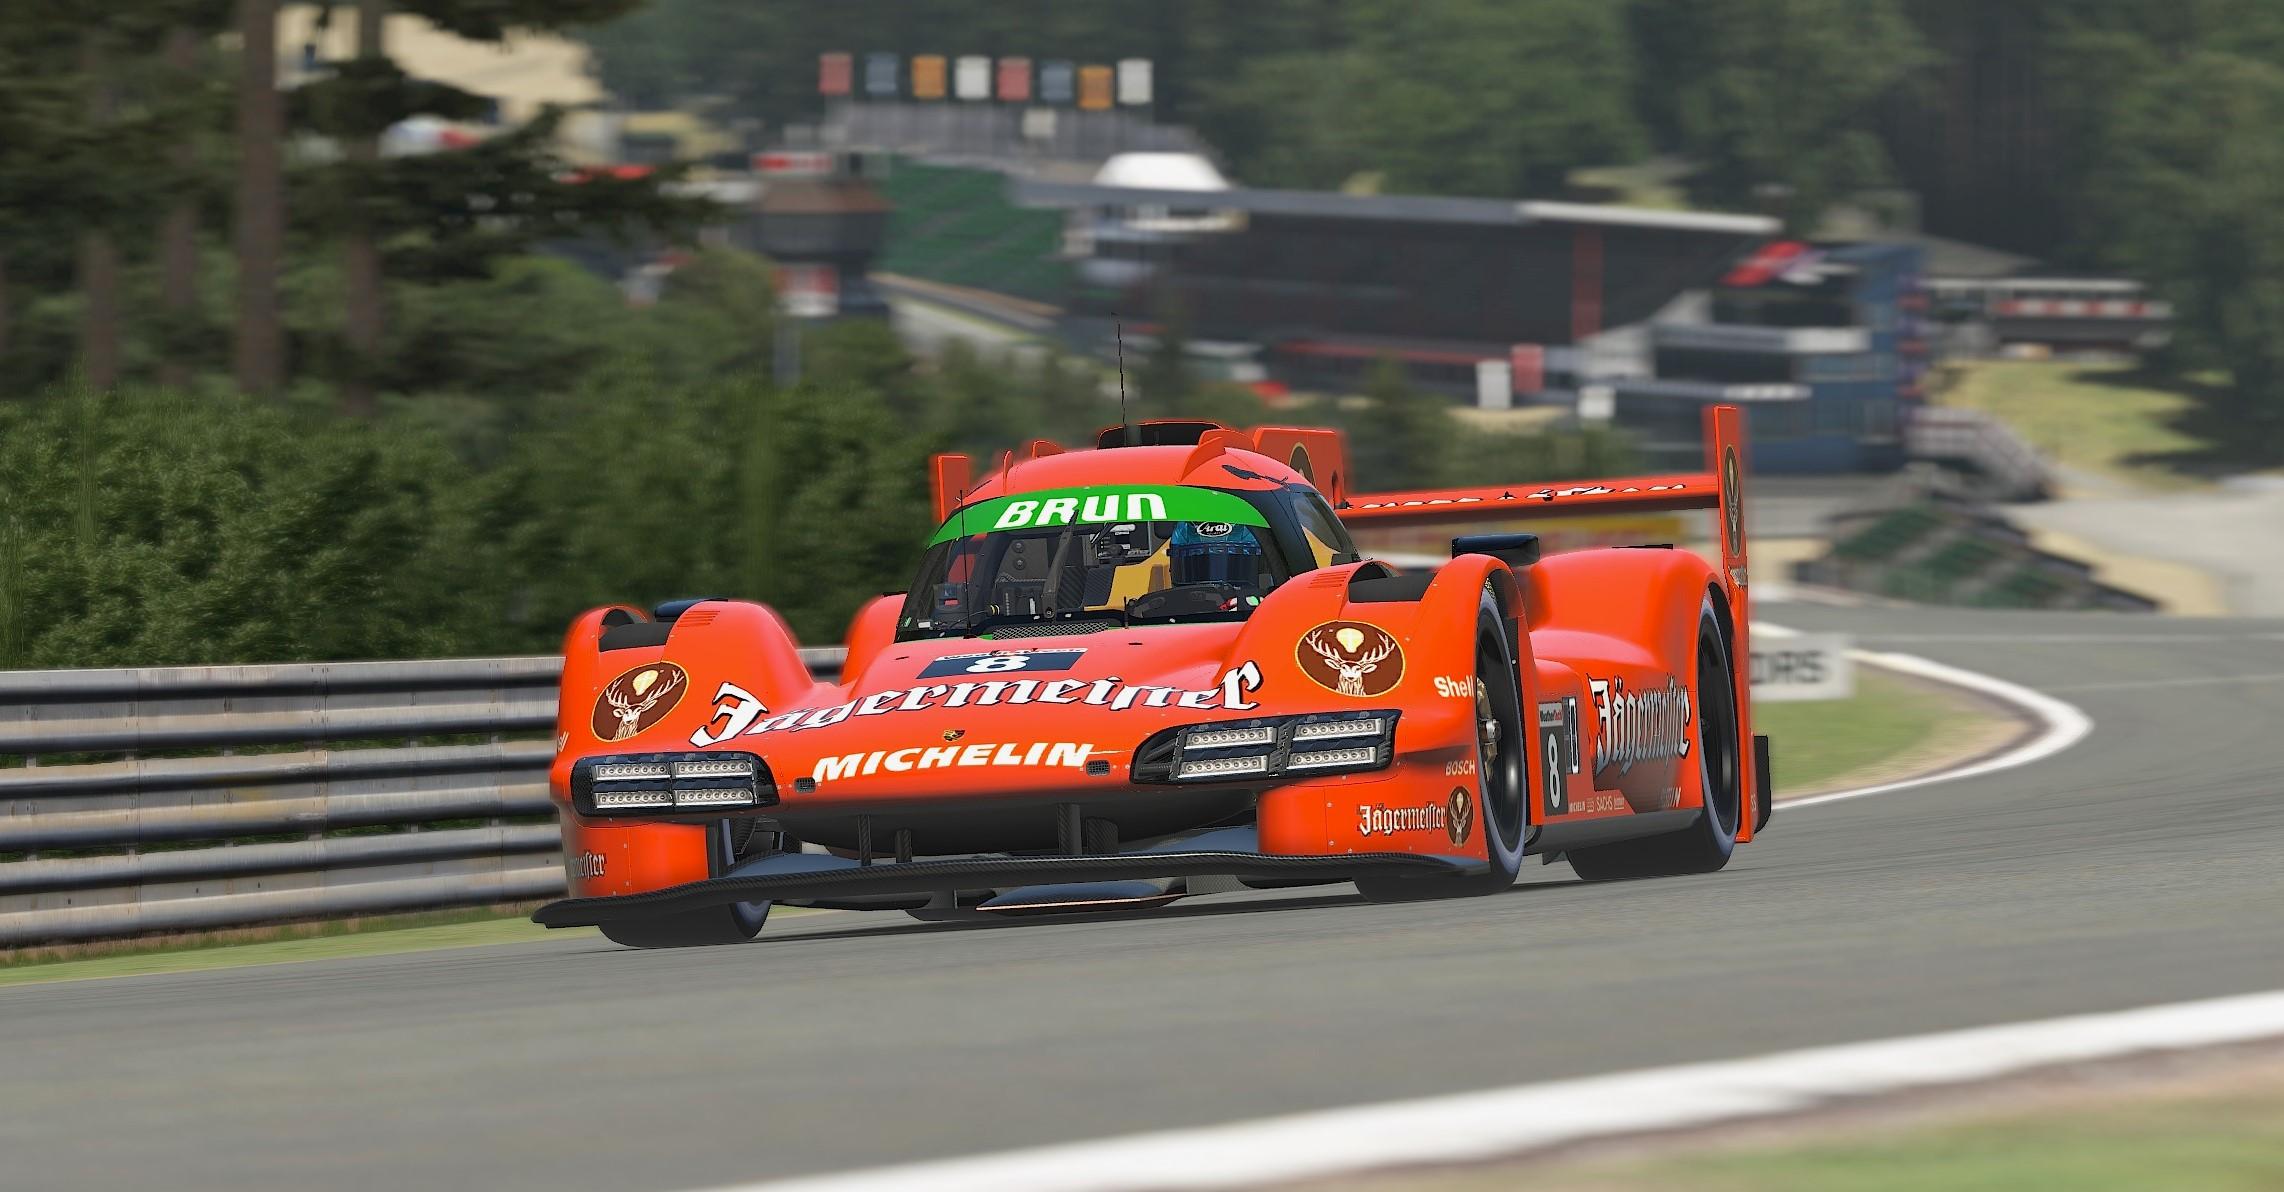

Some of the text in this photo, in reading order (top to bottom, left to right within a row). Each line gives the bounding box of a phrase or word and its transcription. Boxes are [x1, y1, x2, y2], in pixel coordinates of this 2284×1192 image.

[993, 494, 1168, 529] BRUN
[966, 655, 1031, 673] 8
[1434, 675, 1475, 698] Shell
[812, 742, 1094, 784] MICHELIN
[1445, 760, 1476, 776] BOSCH
[1547, 733, 1561, 808] 8
[1358, 803, 1446, 836] Jägermeister
